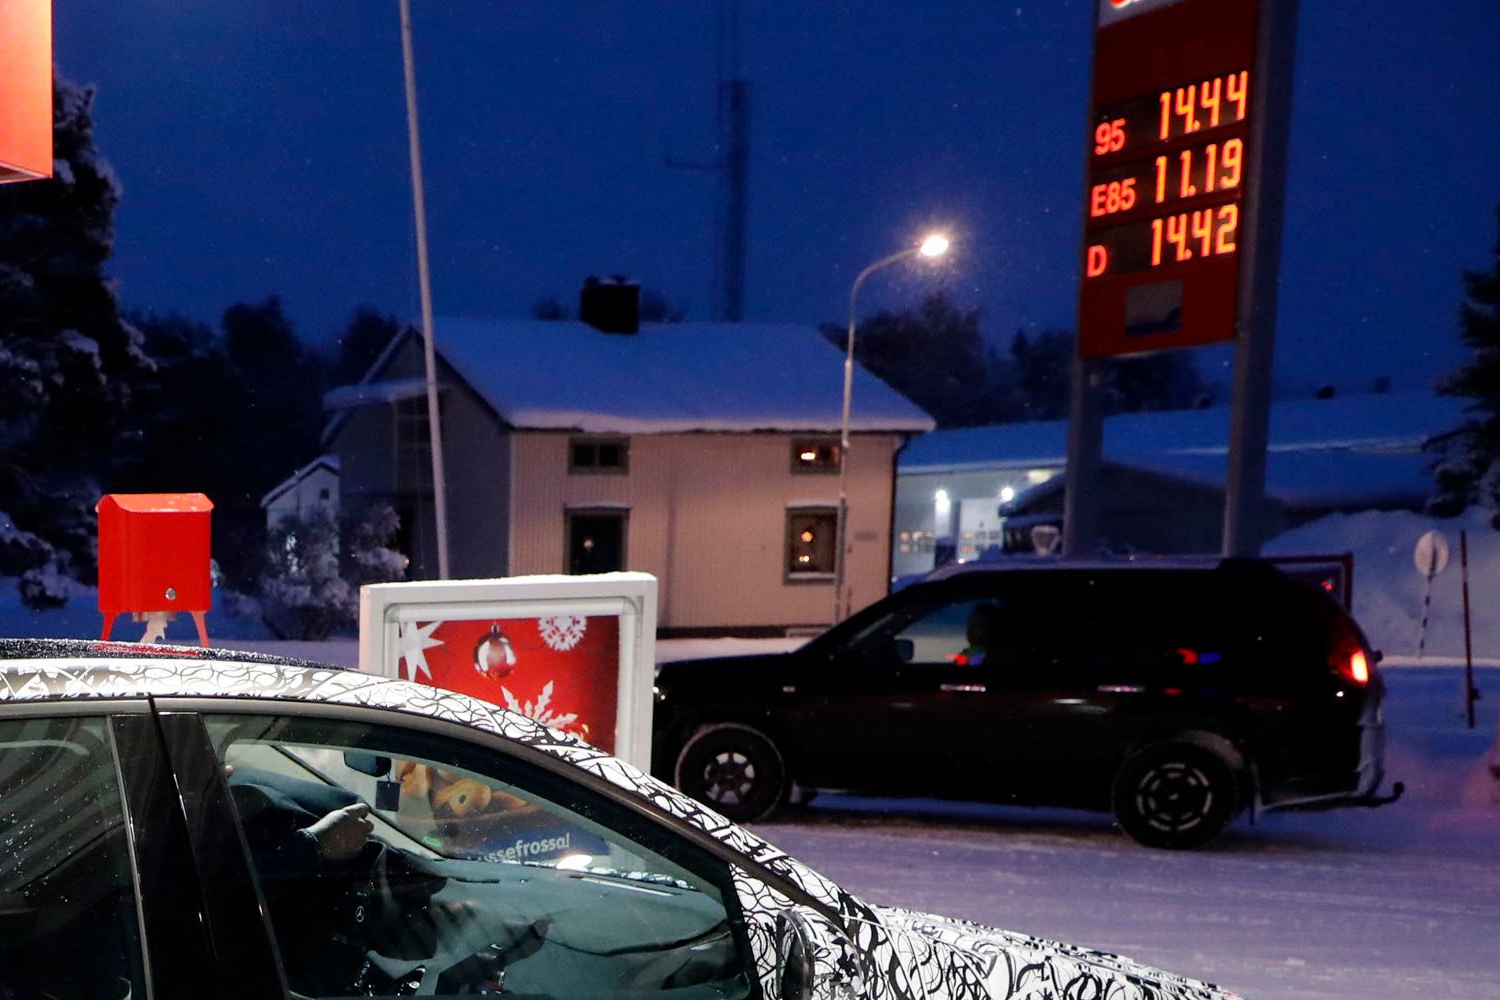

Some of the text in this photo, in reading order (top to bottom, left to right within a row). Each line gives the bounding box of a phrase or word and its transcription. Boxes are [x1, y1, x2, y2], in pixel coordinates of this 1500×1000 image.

[1094, 70, 1249, 156] 95 14.44
[1090, 137, 1244, 217] E85 11.19
[1086, 203, 1239, 278] D 14.42
